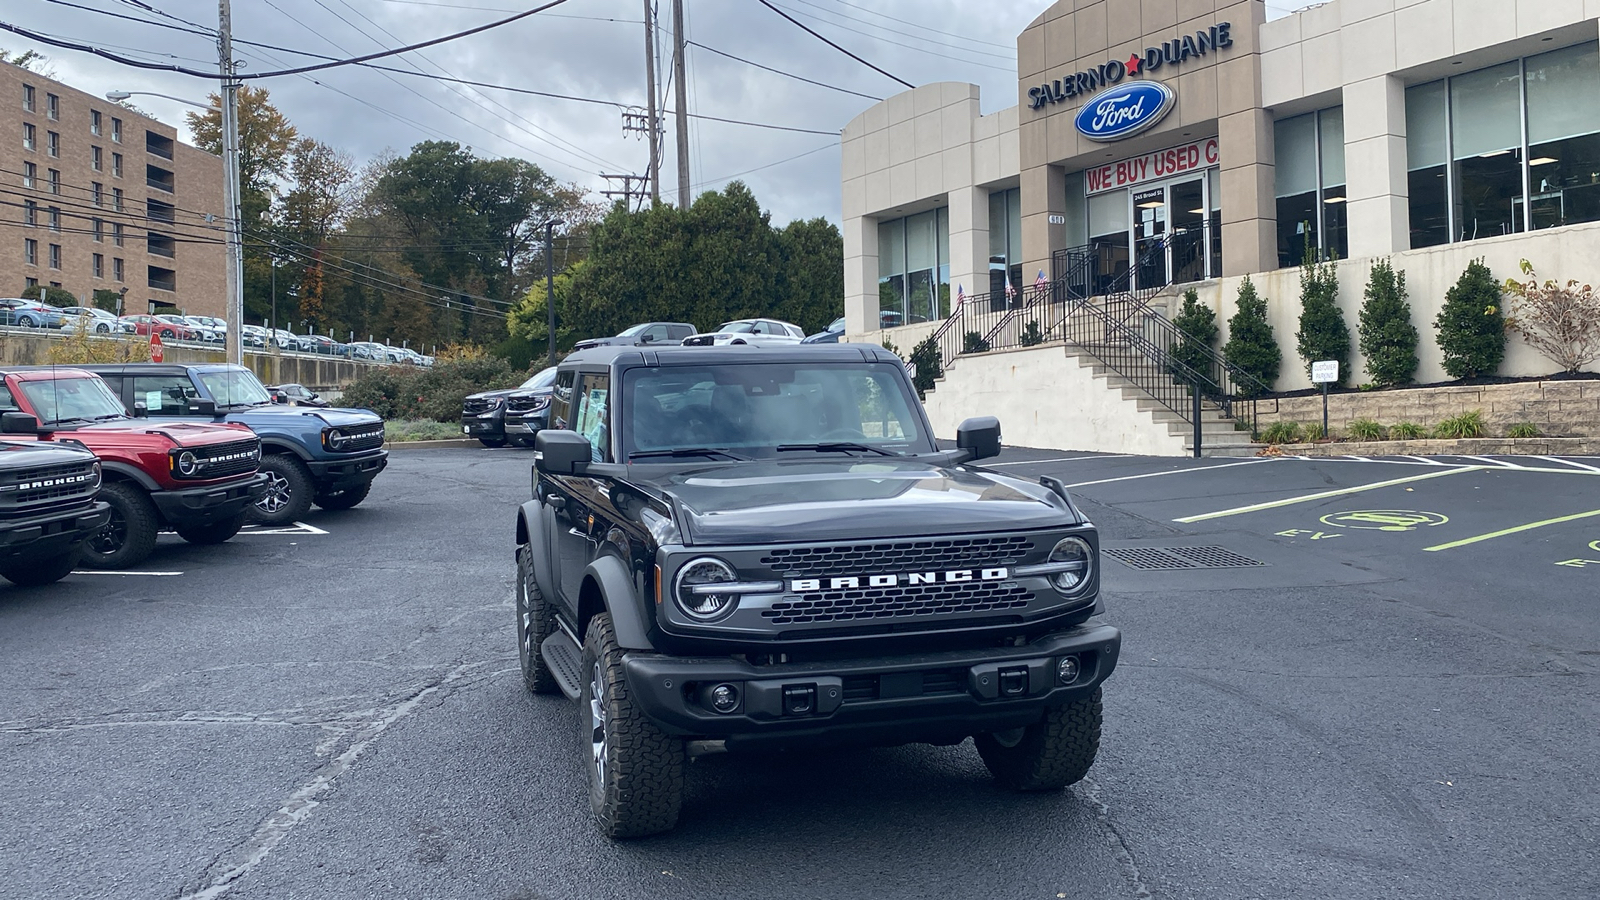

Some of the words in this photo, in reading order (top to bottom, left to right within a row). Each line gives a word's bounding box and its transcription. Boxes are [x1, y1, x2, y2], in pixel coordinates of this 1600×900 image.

[1027, 59, 1125, 110] SALERNO
[1144, 22, 1233, 71] DUANE
[1092, 93, 1144, 131] Ford
[1087, 166, 1112, 192] WE
[1116, 157, 1150, 185] BUY
[1154, 144, 1200, 176] USED
[1205, 139, 1218, 164] C
[151, 343, 162, 357] STOP
[1314, 363, 1337, 371] CUSTOMER
[1316, 372, 1334, 380] PARKING
[210, 451, 253, 463] BRONCO
[19, 475, 85, 490] BRONCO
[791, 567, 1008, 592] BRONCO
